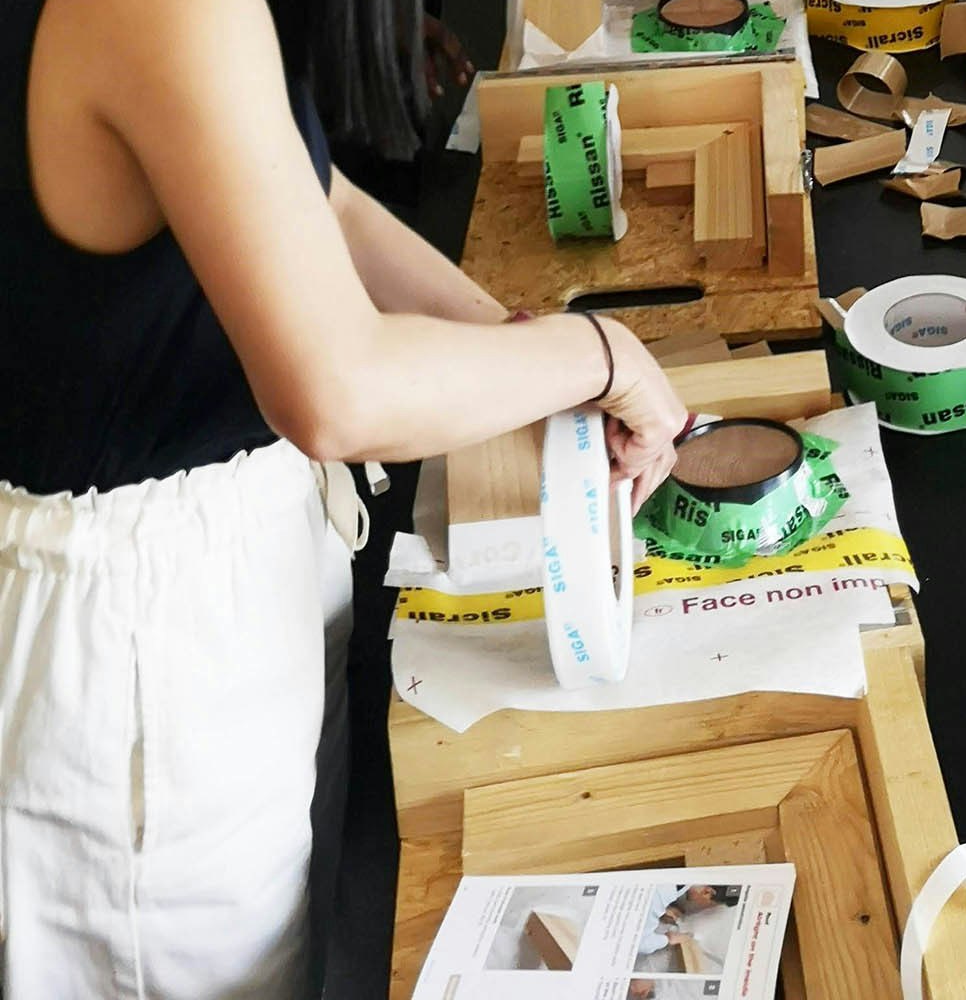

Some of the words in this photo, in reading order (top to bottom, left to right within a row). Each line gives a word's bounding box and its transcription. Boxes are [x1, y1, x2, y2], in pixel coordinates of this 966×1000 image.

[868, 25, 924, 48] Sicrall
[581, 135, 610, 209] Rissan
[917, 325, 948, 337] SIGA
[721, 529, 758, 544] SIGA
[545, 543, 567, 593] SIGA
[663, 575, 702, 585] SIGA
[682, 591, 756, 615] Face
[766, 580, 823, 603] non
[567, 629, 590, 663] SIGA
